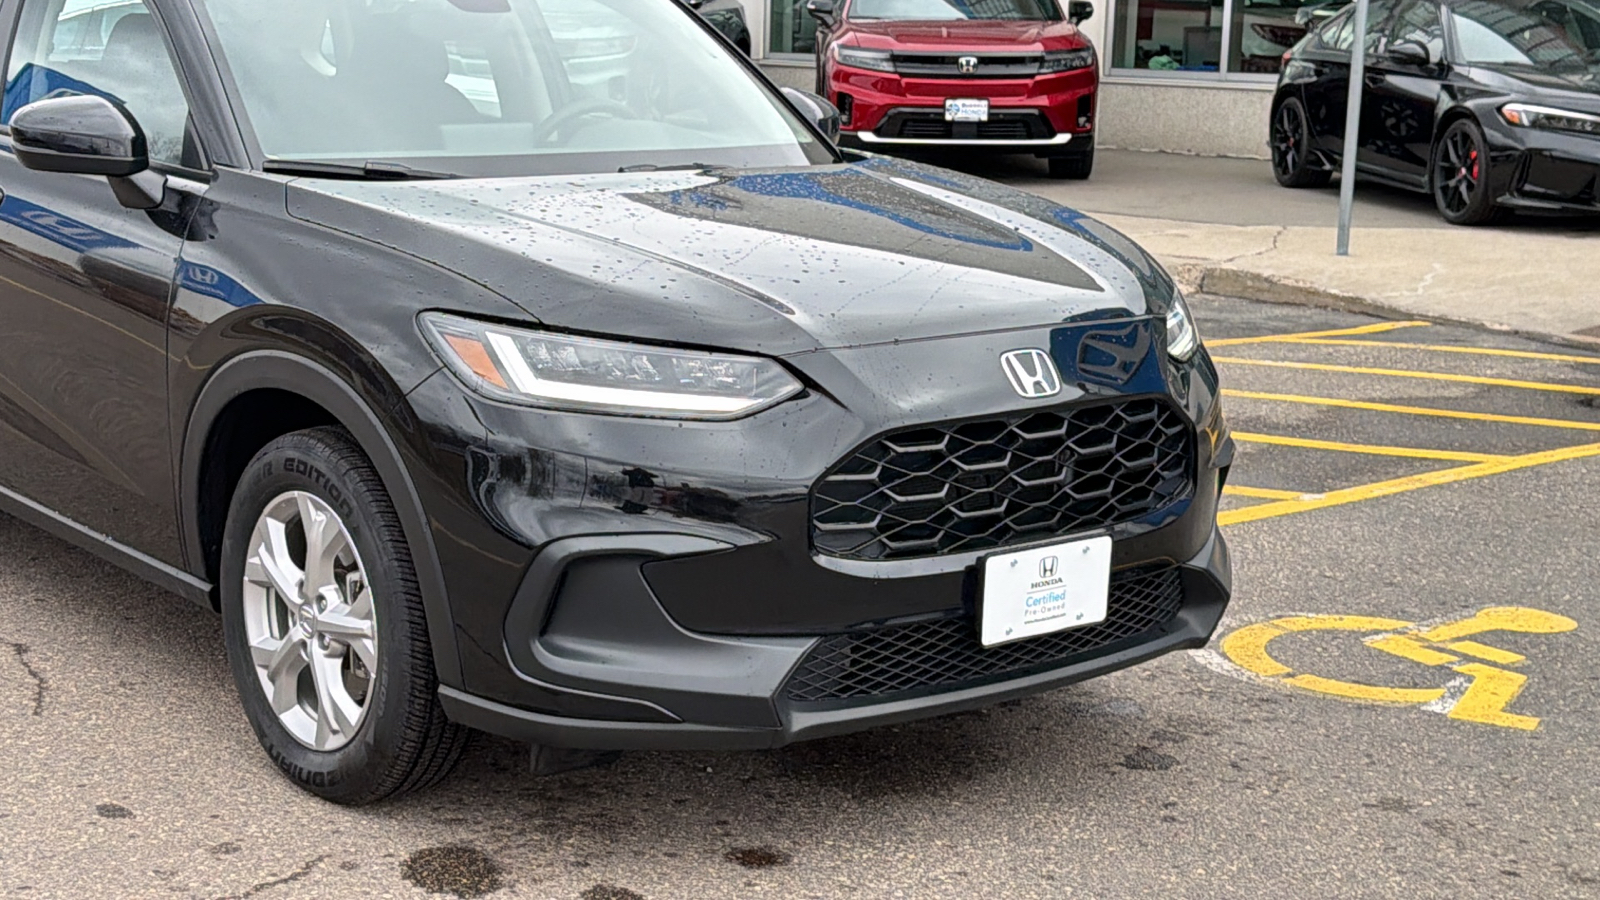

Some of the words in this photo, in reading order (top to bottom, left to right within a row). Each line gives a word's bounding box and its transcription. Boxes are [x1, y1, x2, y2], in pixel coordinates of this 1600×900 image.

[283, 456, 354, 519] EDITION
[1031, 577, 1064, 589] HONDA
[1025, 590, 1067, 608] Certified
[1024, 603, 1066, 617] Pre-Owned
